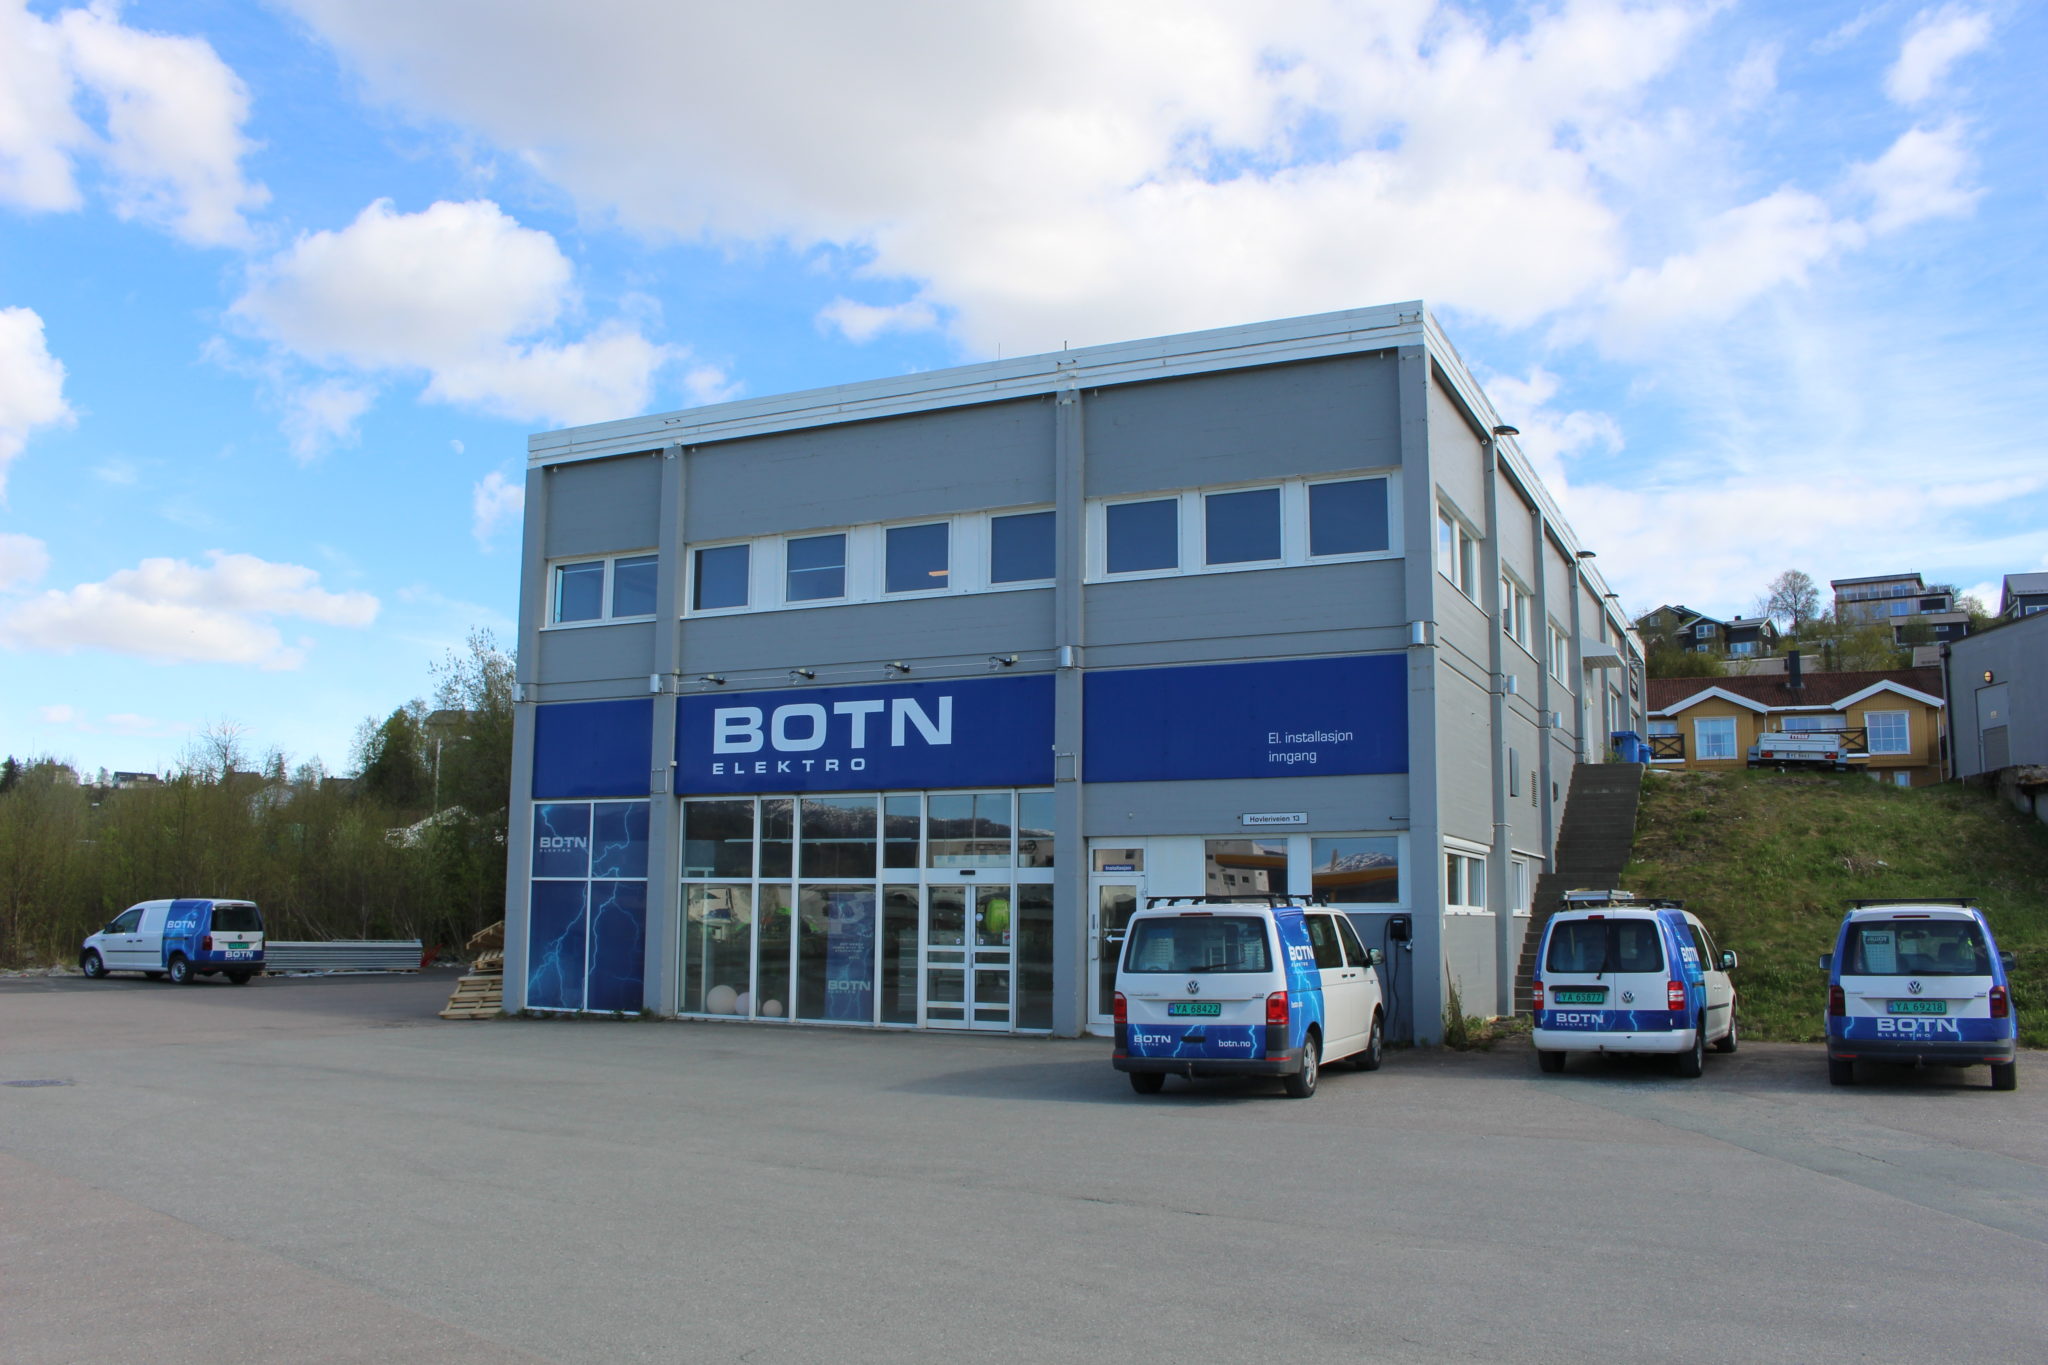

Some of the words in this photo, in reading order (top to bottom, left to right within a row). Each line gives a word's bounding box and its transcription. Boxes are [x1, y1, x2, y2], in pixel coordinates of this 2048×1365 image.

[713, 695, 953, 755] BOTN
[1268, 732, 1282, 744] El.
[1285, 729, 1353, 744] installasjon
[1268, 750, 1317, 765] inngang
[712, 758, 866, 775] ELEKTRO
[540, 836, 587, 848] BOTN
[167, 920, 196, 929] BOTN
[1288, 945, 1314, 961] BOTN
[1681, 947, 1700, 962] BOTN
[828, 980, 871, 991] BOTN
[1562, 993, 1573, 1001] YA
[1175, 1004, 1188, 1013] YA
[1190, 1004, 1219, 1014] 68422
[1896, 1003, 1909, 1011] YA
[1913, 1002, 1943, 1011] 69218
[1556, 1013, 1604, 1023] BOTN
[1877, 1018, 1957, 1032] BOTN
[1133, 1035, 1171, 1043] BOTN
[1218, 1040, 1251, 1048] botn.no
